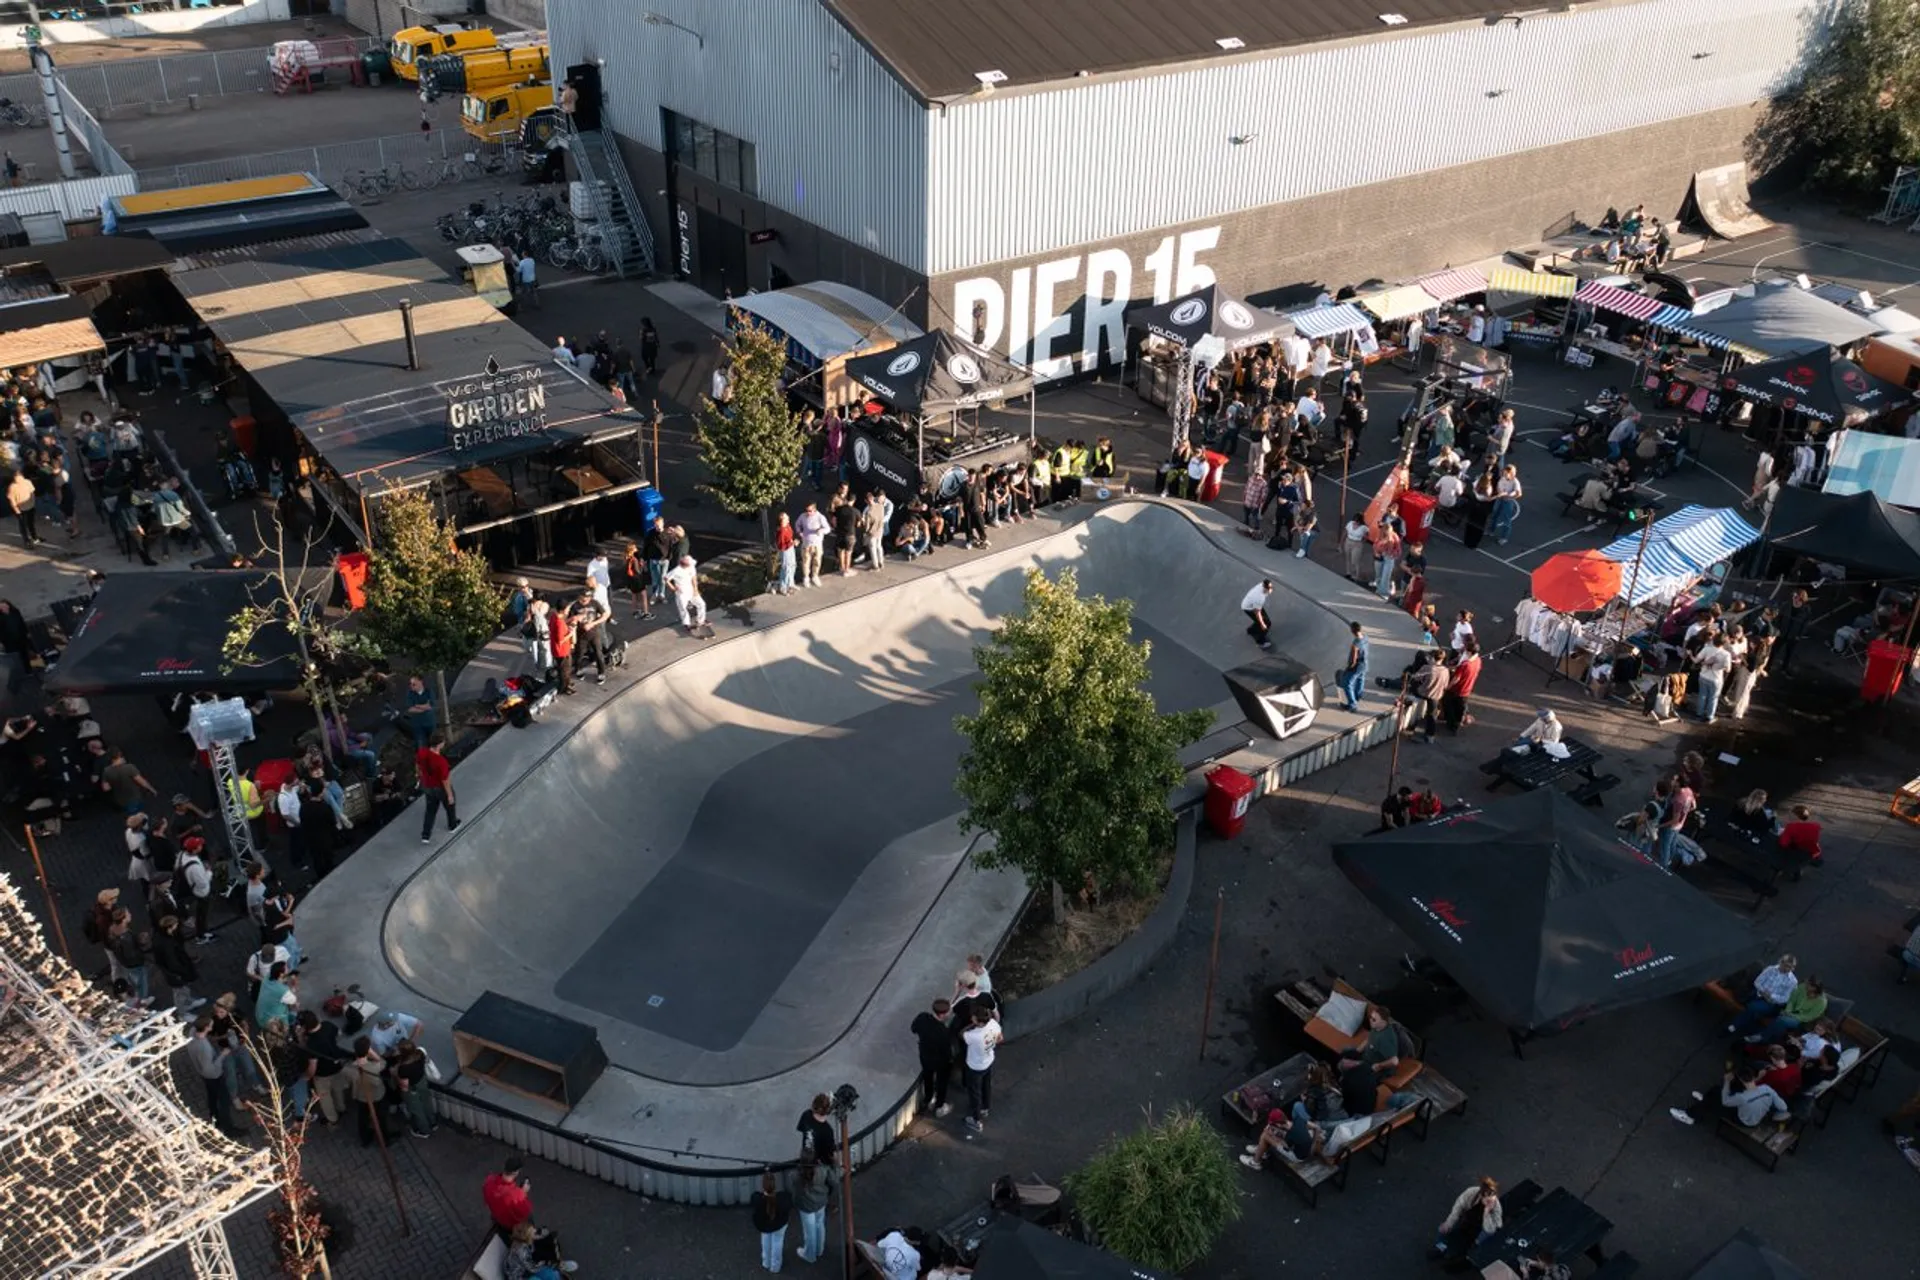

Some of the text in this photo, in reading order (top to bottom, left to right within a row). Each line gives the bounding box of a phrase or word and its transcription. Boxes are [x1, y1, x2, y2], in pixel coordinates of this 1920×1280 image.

[954, 226, 1222, 386] PIER 15
[1147, 322, 1188, 348] VOLCOM
[1232, 331, 1275, 348] VOLCOM
[863, 375, 896, 399] VOLCOM
[954, 388, 1004, 405] VOLCOM
[1736, 384, 1773, 402] 24MX
[450, 384, 546, 429] GARDEN
[1795, 403, 1834, 423] 24MX
[453, 414, 549, 451] EXPERIENCE
[872, 461, 908, 487] VOLCOM
[1613, 942, 1656, 968] Bud
